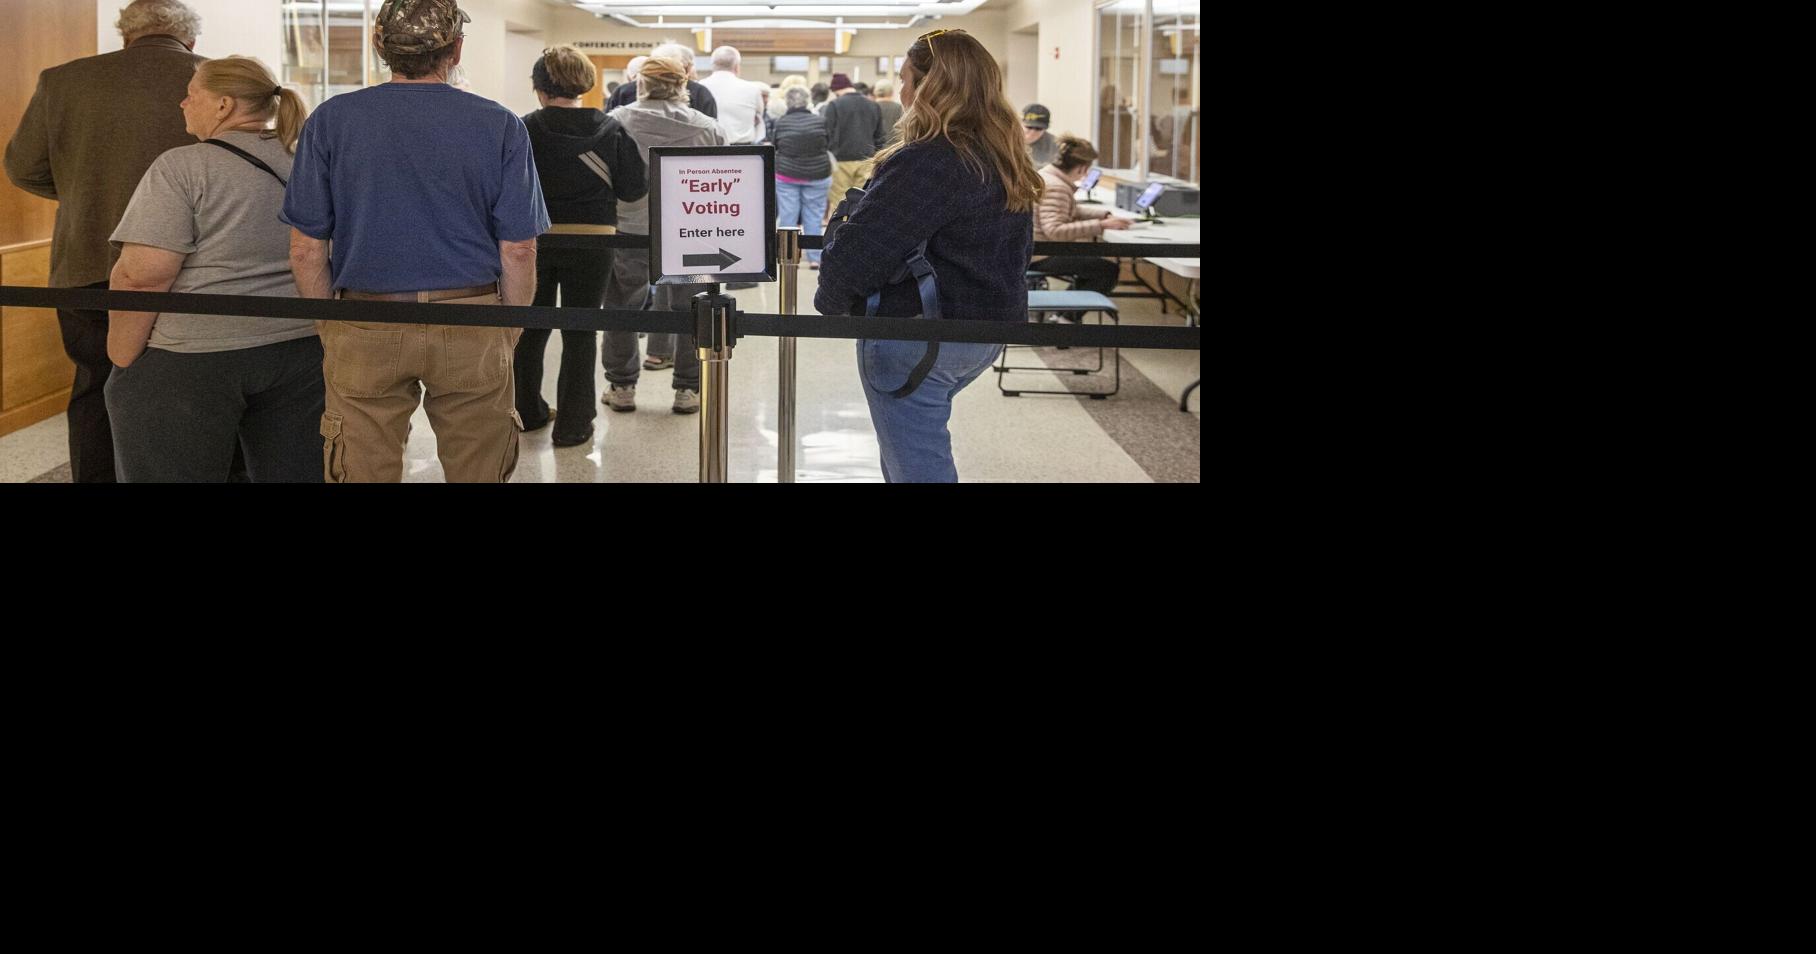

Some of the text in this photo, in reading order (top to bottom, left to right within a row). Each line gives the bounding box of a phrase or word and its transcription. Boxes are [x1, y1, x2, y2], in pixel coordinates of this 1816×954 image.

[681, 178, 740, 195] “Early”
[682, 201, 740, 217] Voting
[679, 227, 745, 238] Enter here
